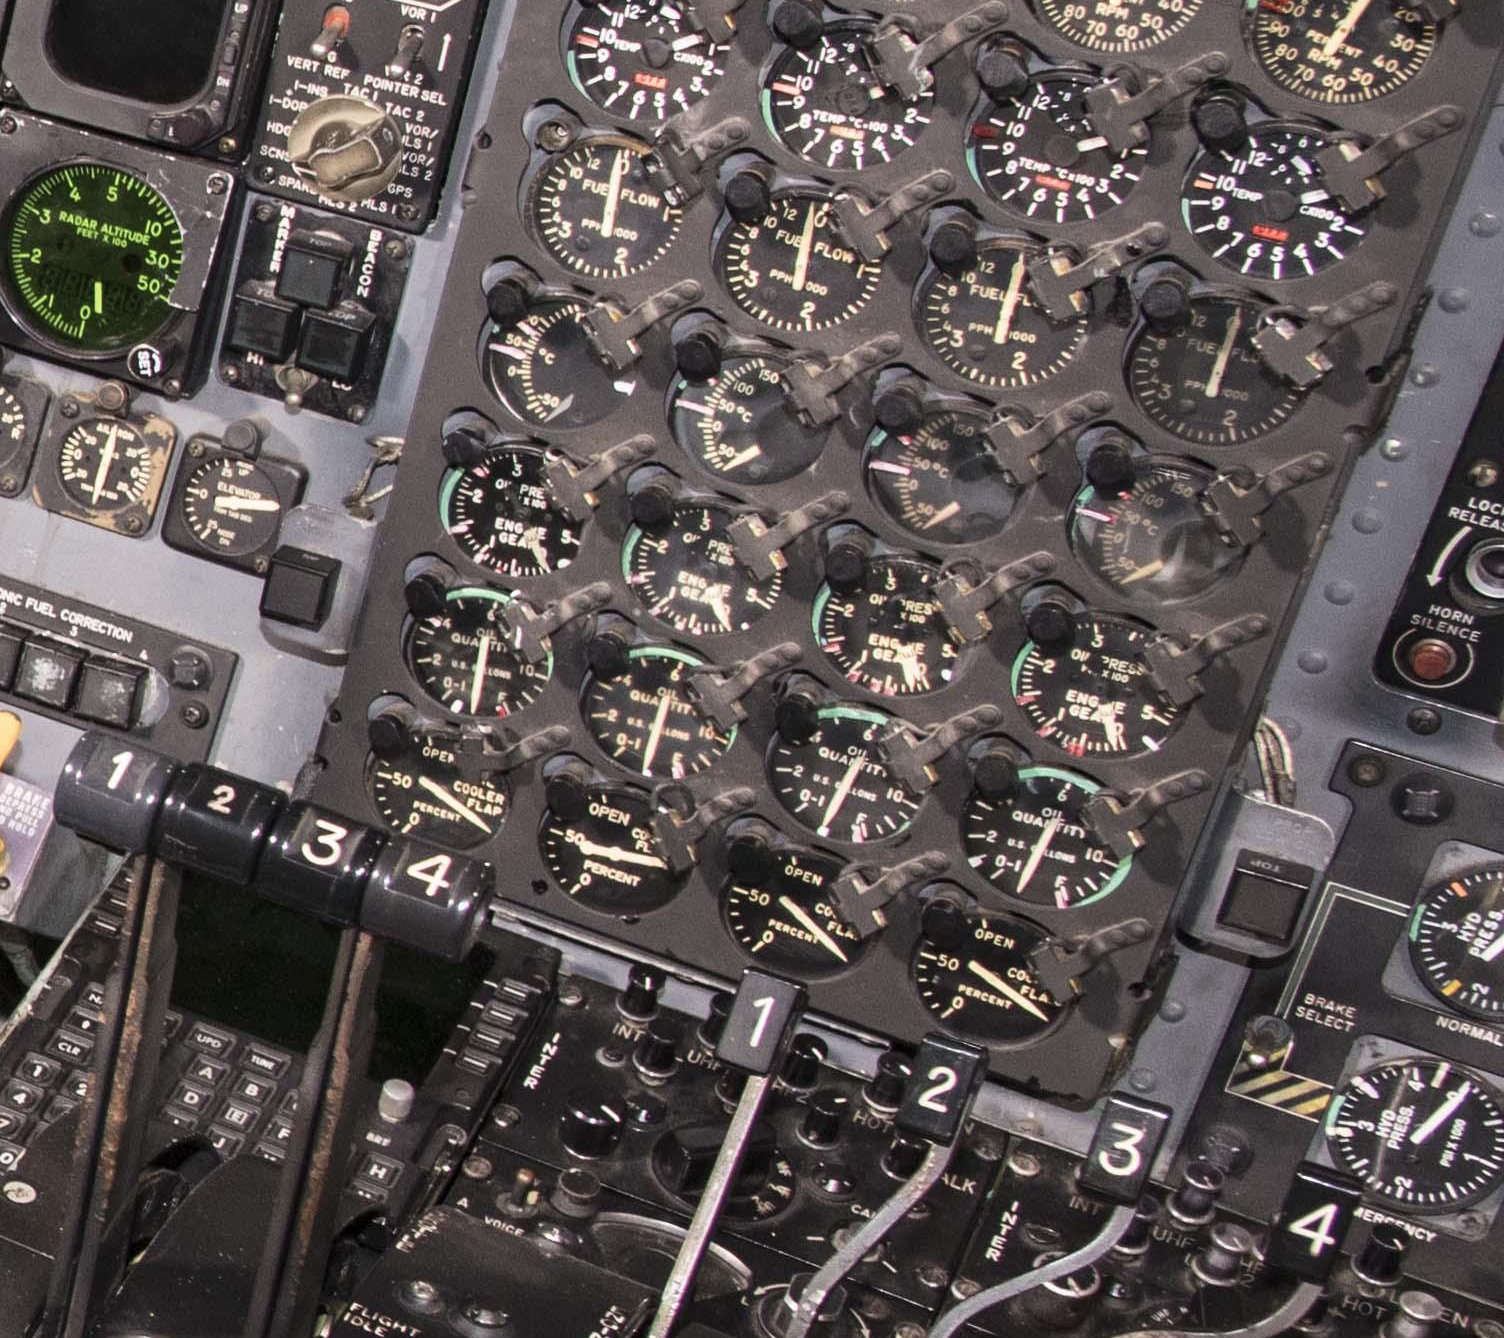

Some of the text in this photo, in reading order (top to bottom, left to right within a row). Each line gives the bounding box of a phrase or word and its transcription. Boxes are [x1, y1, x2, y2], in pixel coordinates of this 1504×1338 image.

[1095, 2, 1128, 20] RPM
[288, 55, 351, 79] VERT REF
[364, 74, 447, 106] POINTER SEL
[387, 184, 413, 198] GPS
[58, 210, 150, 247] RADAR ALTITUDE
[137, 350, 151, 377] SET
[24, 595, 55, 619] FUEL
[59, 610, 134, 643] CORRECTION
[1410, 614, 1481, 642] SILENCE
[1429, 605, 1475, 625] HORN
[109, 752, 132, 789] 1
[4, 782, 51, 810] BRAKE
[207, 784, 236, 815] 2
[589, 804, 631, 826] OPEN
[301, 819, 343, 865] 3
[408, 854, 450, 895] 4
[583, 861, 641, 887] PERCENT
[785, 866, 823, 886] OPEN
[974, 929, 1015, 948] OPEN
[1295, 1006, 1355, 1032] SELECT
[1304, 993, 1357, 1019] BRAKE
[749, 997, 776, 1048] 1
[1436, 1016, 1504, 1046] NORMAL
[58, 1041, 81, 1055] CLR
[525, 1032, 560, 1088] INTER
[919, 1066, 958, 1112] 2
[1098, 1122, 1144, 1177] 3
[986, 1201, 1020, 1262] INTER
[1290, 1203, 1340, 1256] 4
[344, 1314, 386, 1338] IDLE
[350, 1302, 422, 1338] FLIGHT
